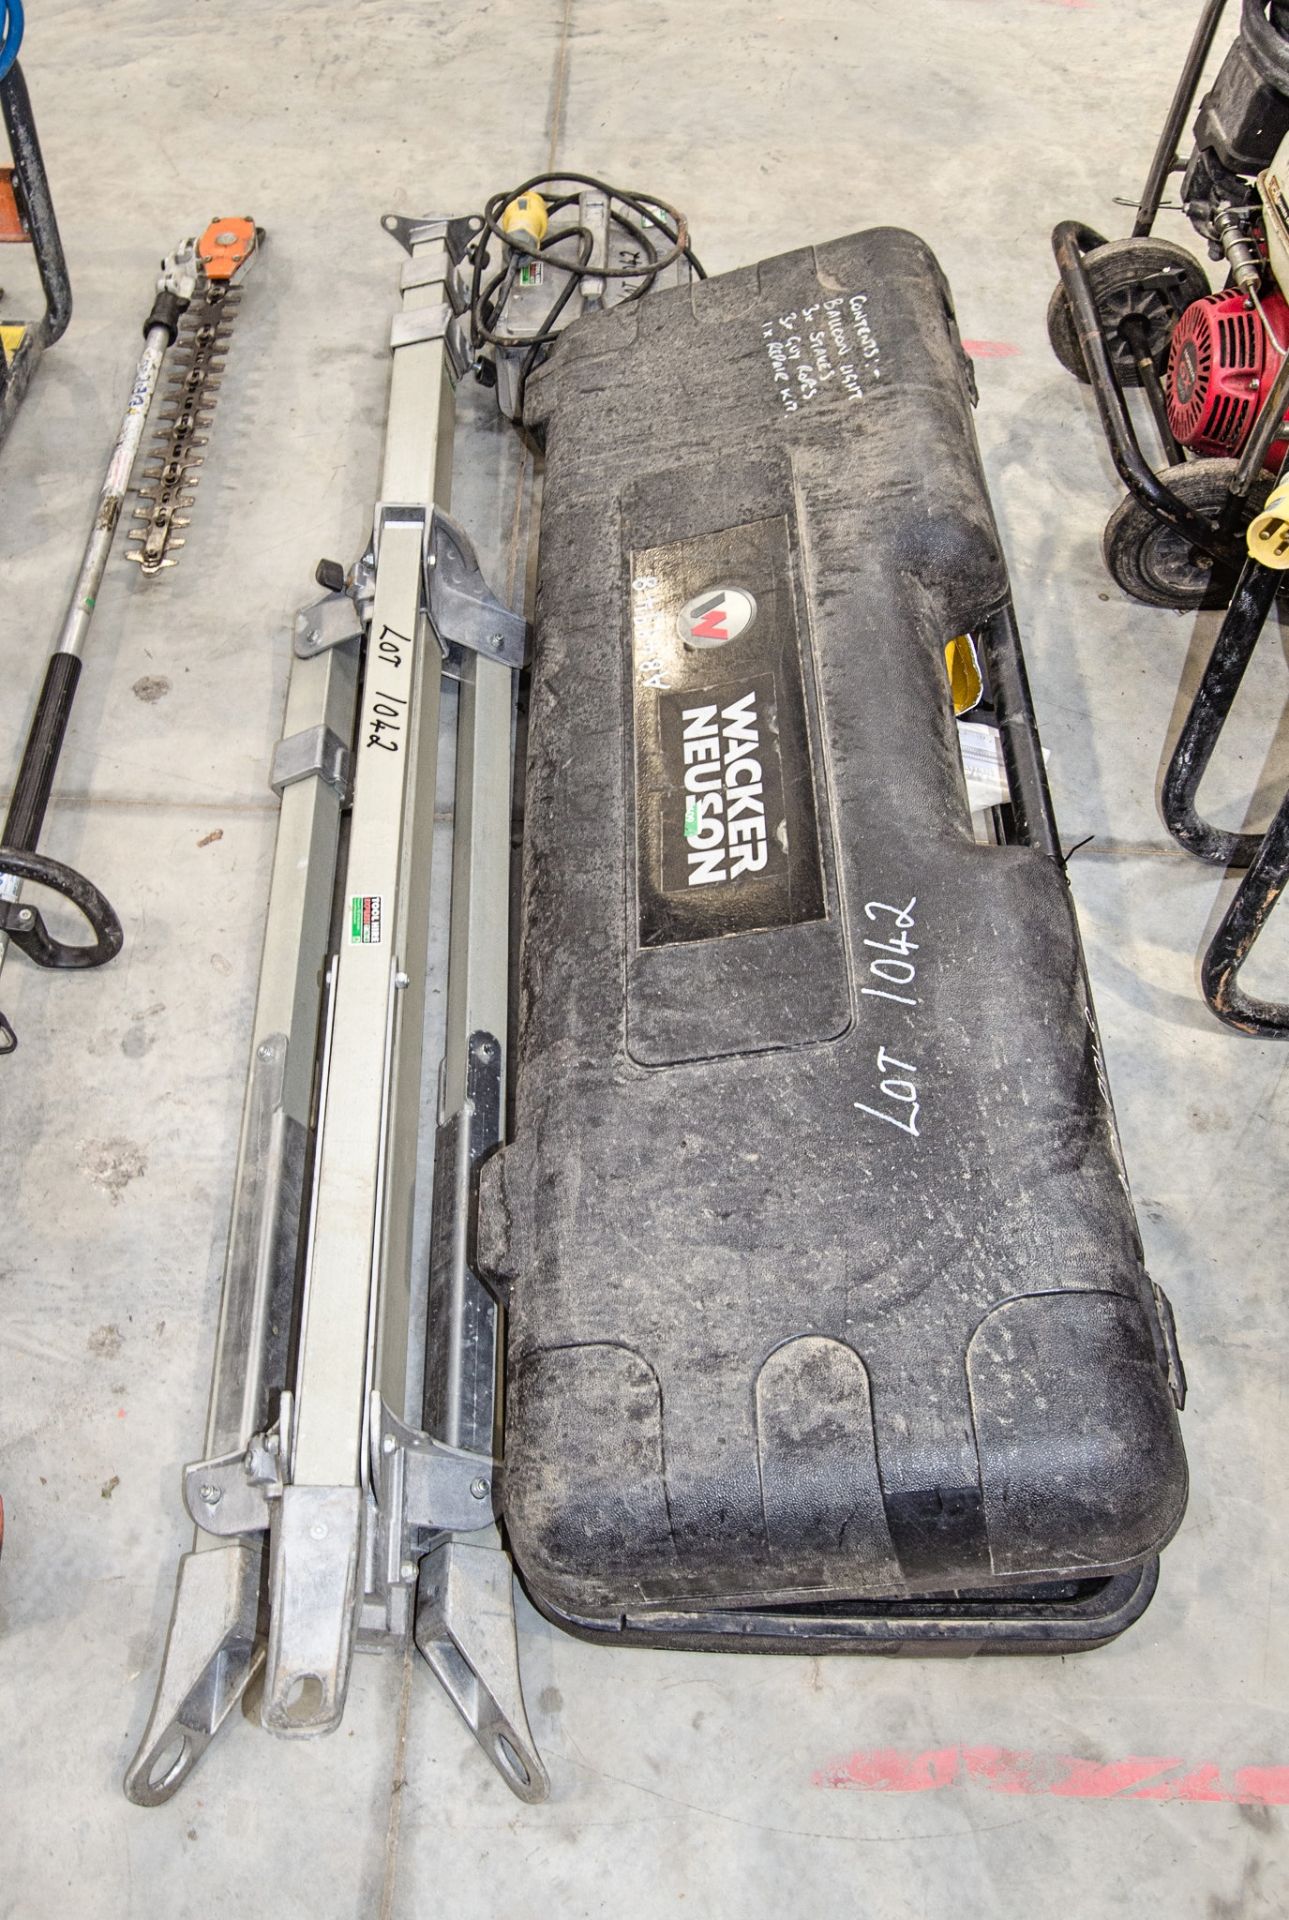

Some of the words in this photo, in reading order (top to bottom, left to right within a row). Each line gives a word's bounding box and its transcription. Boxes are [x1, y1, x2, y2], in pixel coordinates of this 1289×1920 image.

[378, 624, 411, 668] LOT
[366, 691, 407, 751] 1042
[682, 704, 727, 886] NEUSON
[721, 691, 768, 880] WACKER
[371, 897, 380, 921] TOOL
[861, 897, 920, 1006] 1042
[854, 1046, 920, 1136] LOT
